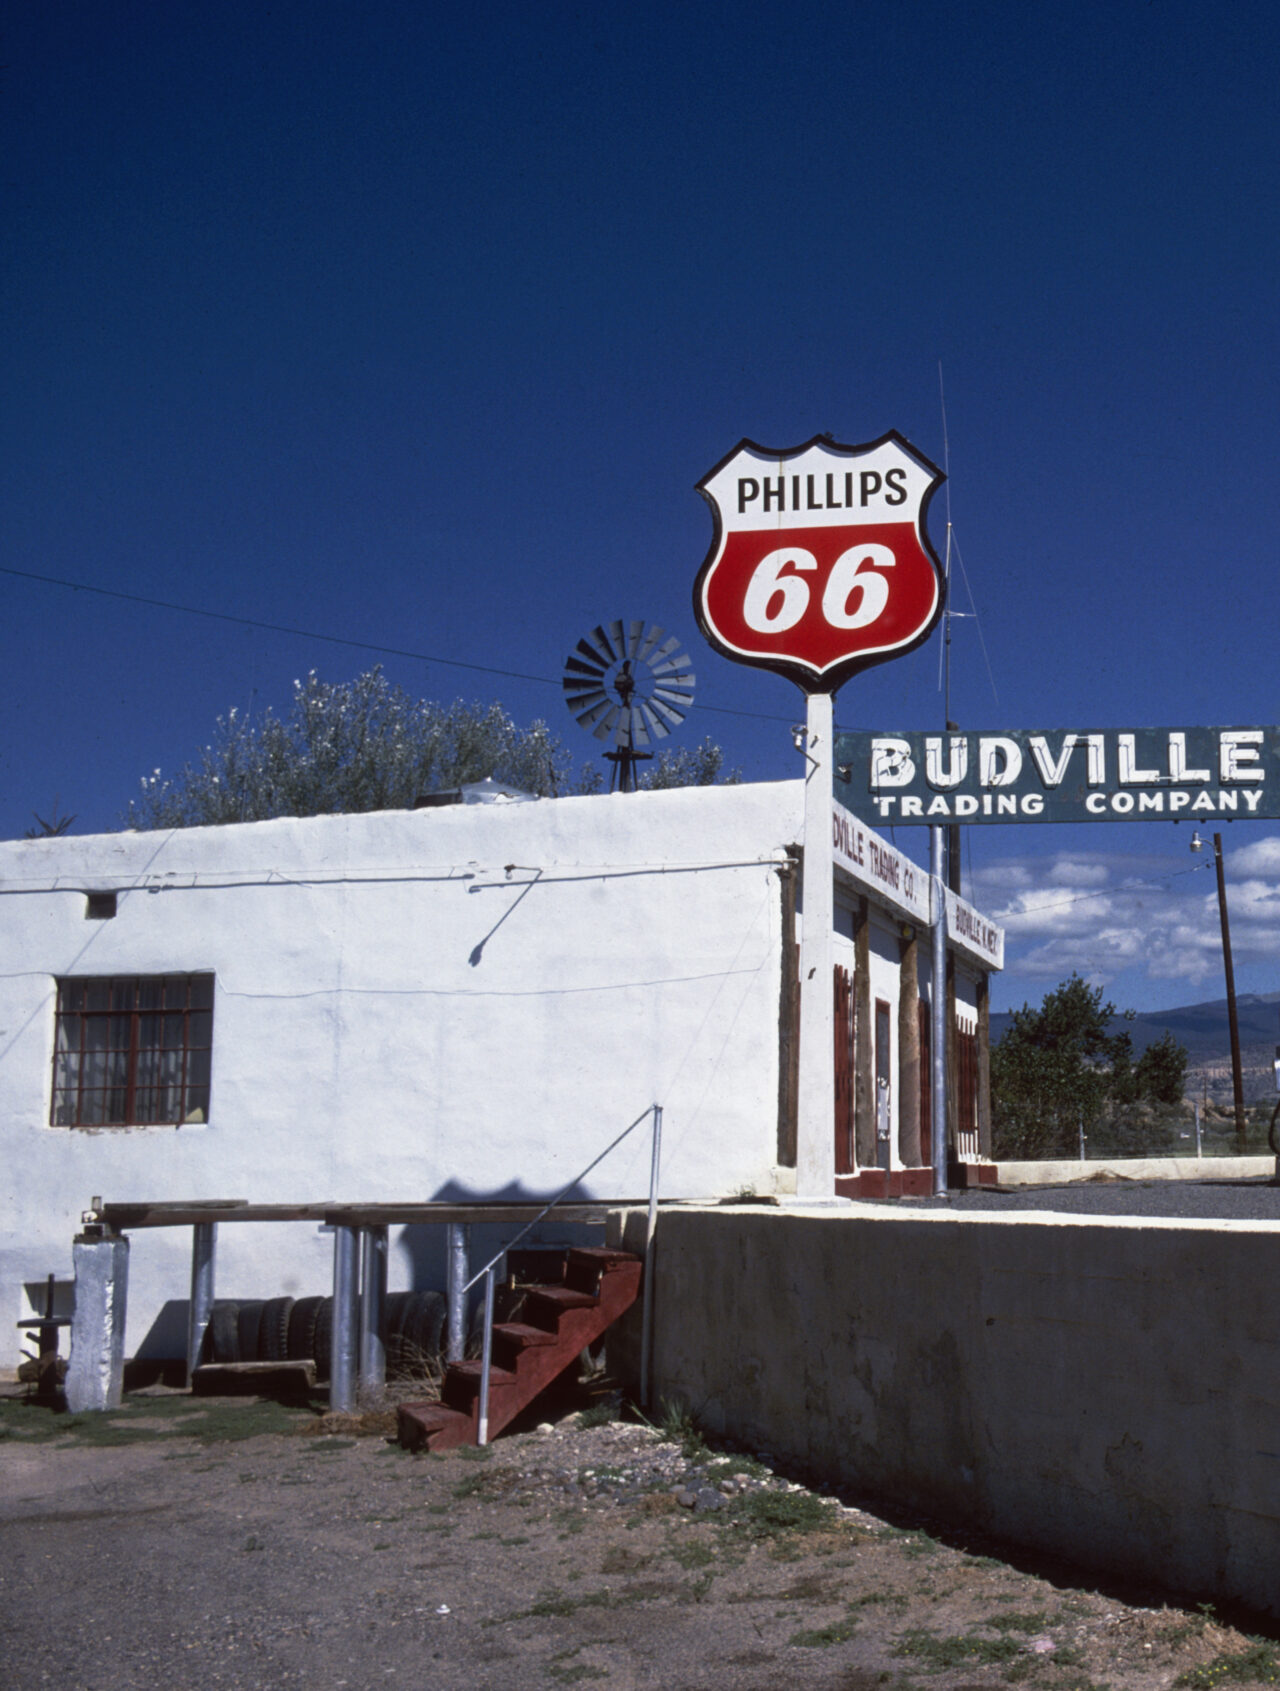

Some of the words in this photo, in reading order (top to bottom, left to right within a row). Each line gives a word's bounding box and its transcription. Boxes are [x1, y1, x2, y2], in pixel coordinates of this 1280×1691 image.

[738, 468, 907, 513] PHILLIPS
[743, 543, 896, 634] 66
[871, 731, 1265, 787] BUDVILLE
[873, 793, 1044, 816] TRADING
[1085, 790, 1264, 814] COMPANY
[869, 840, 900, 890] TRADING
